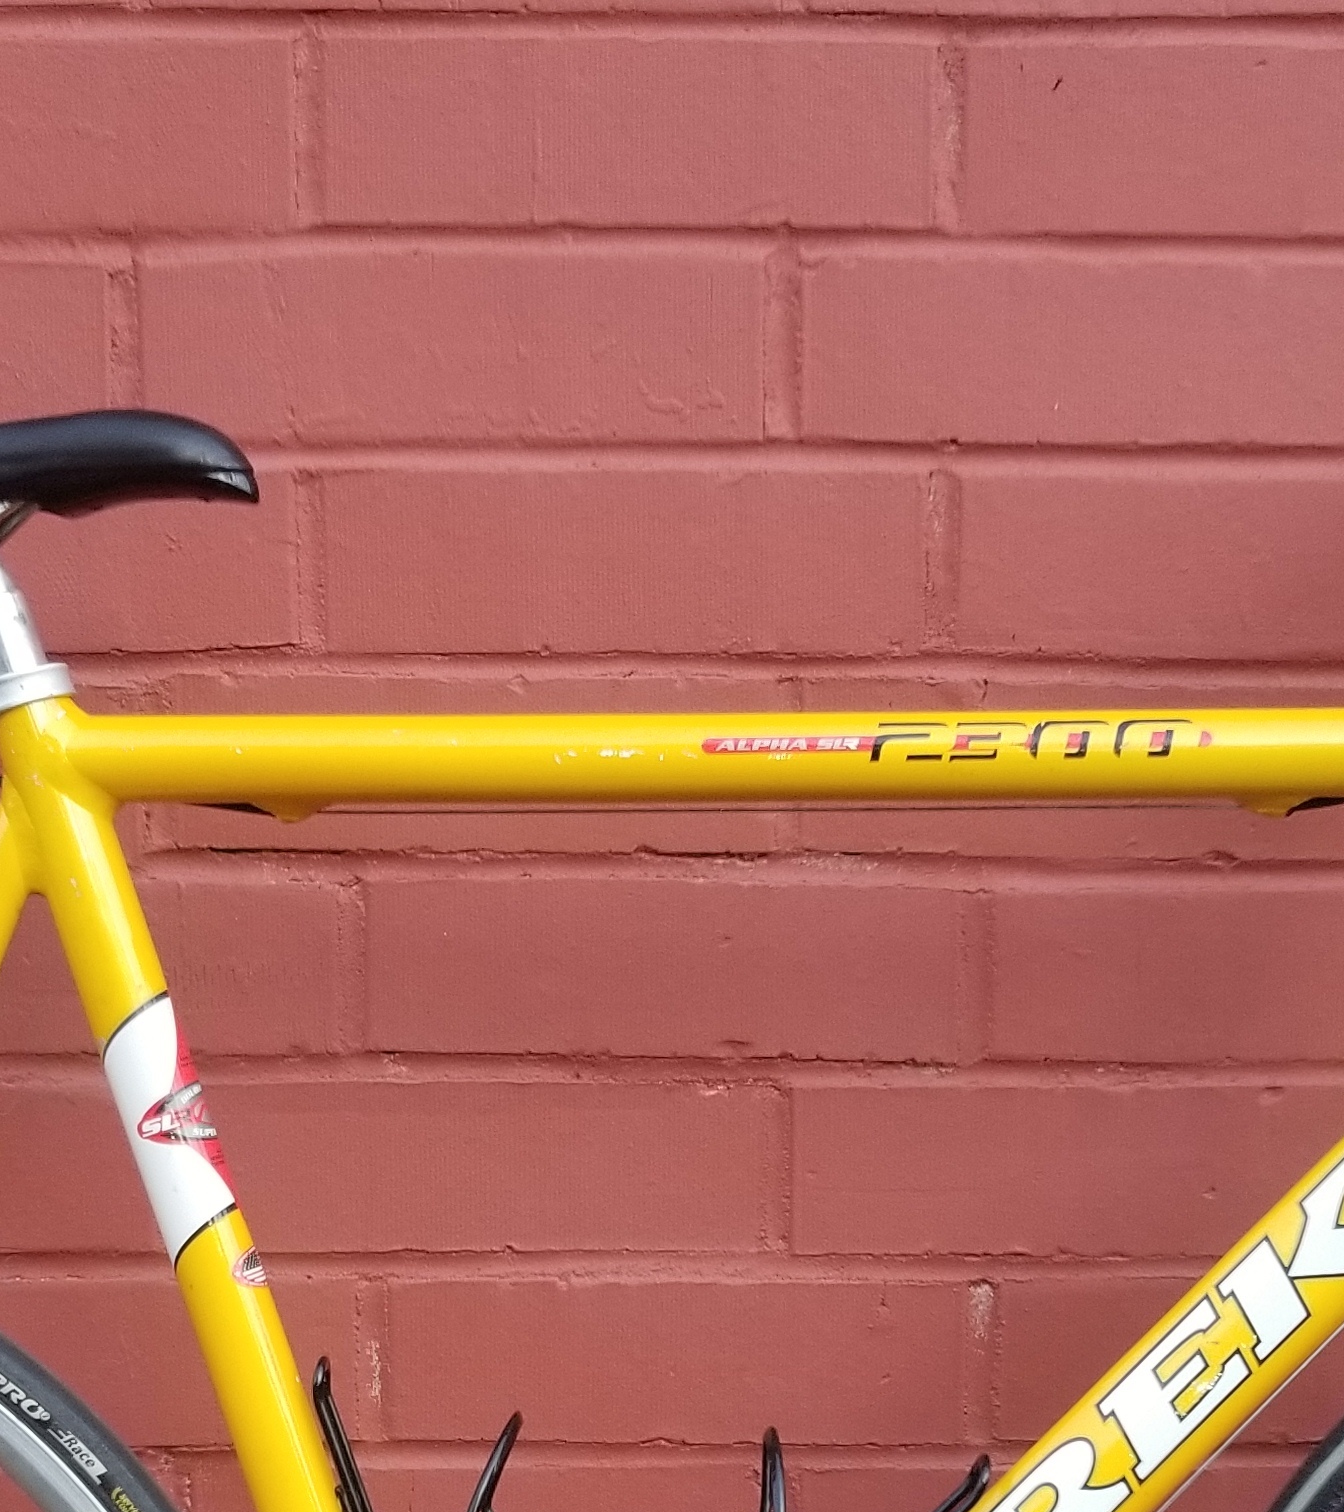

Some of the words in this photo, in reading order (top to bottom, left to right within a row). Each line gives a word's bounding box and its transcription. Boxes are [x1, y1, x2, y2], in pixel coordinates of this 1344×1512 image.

[715, 737, 809, 752] ALPHA
[816, 737, 861, 751] SLR
[869, 719, 1193, 763] 2300
[64, 1435, 97, 1469] Race
